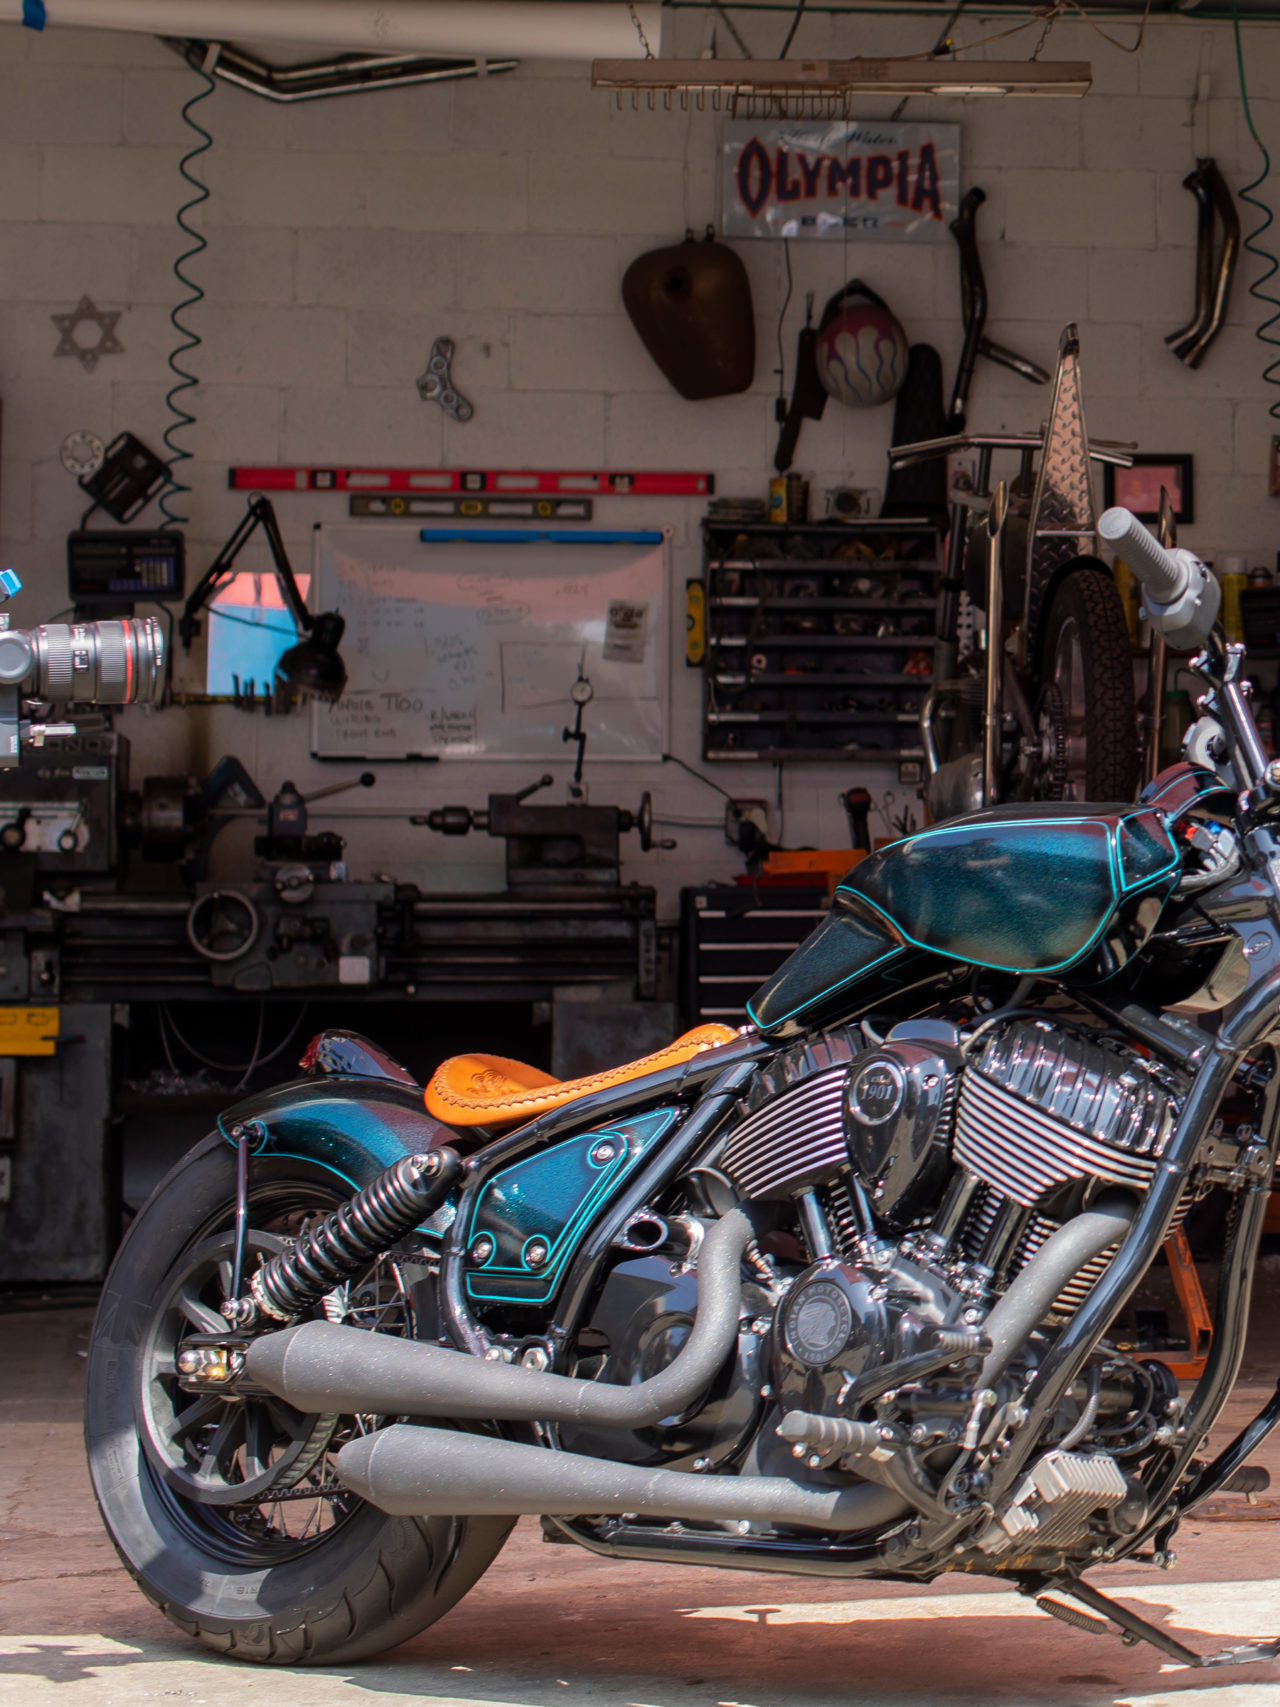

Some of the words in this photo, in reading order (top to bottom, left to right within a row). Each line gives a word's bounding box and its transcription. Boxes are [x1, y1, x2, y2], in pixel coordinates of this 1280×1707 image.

[736, 136, 943, 221] OLYMPIA
[801, 215, 880, 229] BER
[861, 1084, 893, 1100] 1901
